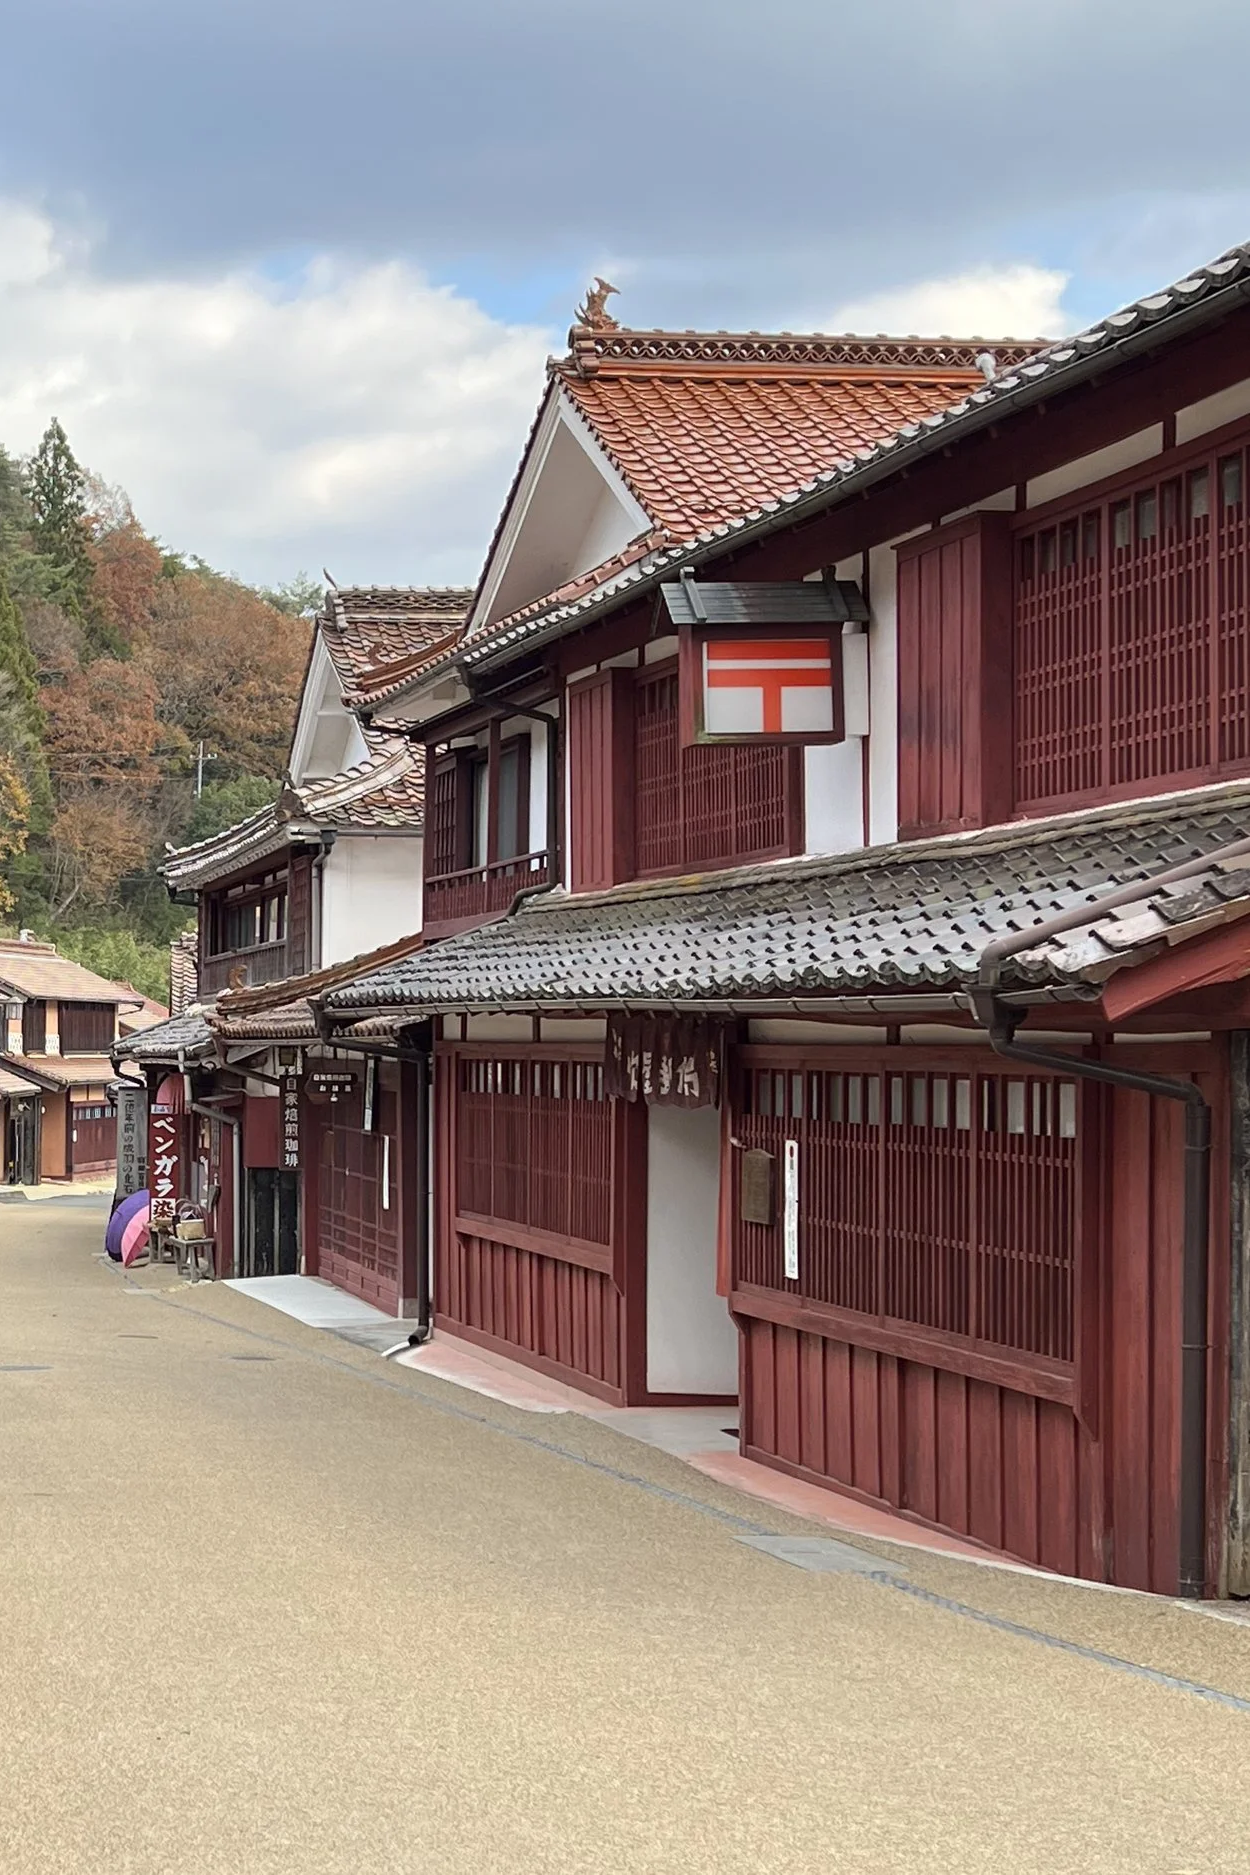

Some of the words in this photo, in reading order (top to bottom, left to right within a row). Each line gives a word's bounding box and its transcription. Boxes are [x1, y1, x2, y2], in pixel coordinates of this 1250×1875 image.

[284, 1077, 299, 1168] 自家焙煎珈琲
